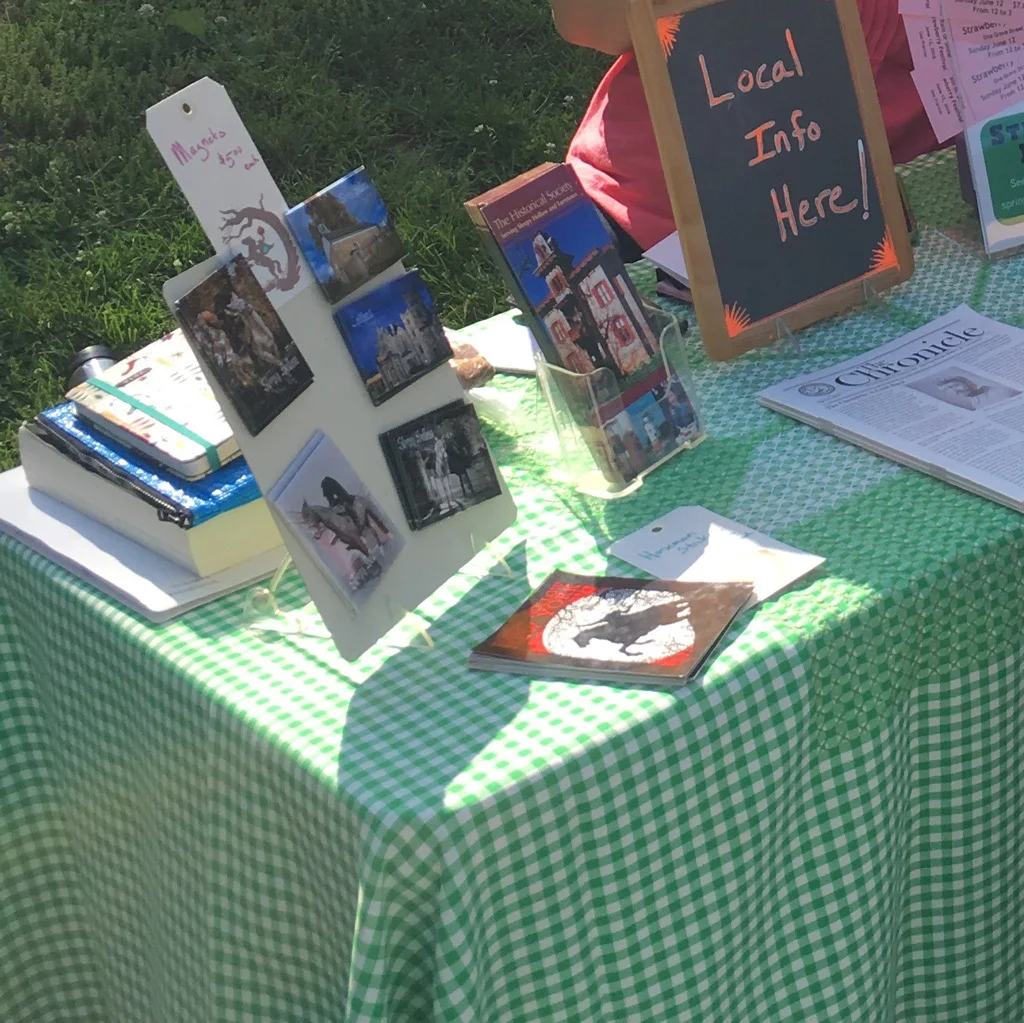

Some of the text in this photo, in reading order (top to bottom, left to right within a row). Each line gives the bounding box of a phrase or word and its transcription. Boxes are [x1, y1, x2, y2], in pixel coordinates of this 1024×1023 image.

[972, 6, 989, 14] From
[991, 7, 998, 16] 12
[968, 43, 991, 55] Sunday
[992, 39, 1007, 48] June
[1008, 36, 1016, 44] 12
[987, 49, 1004, 58] From
[1006, 46, 1013, 55] 12
[1014, 45, 1022, 53] to
[698, 28, 804, 109] Local
[980, 87, 1002, 101] Sunday
[1002, 80, 1018, 93] June
[1000, 89, 1016, 100] From
[1017, 85, 1024, 94] 12
[171, 127, 226, 166] Magnets
[744, 109, 822, 168] Info
[493, 181, 574, 230] The Historical Society
[770, 139, 871, 243] Here!
[835, 327, 985, 387] Chronicle
